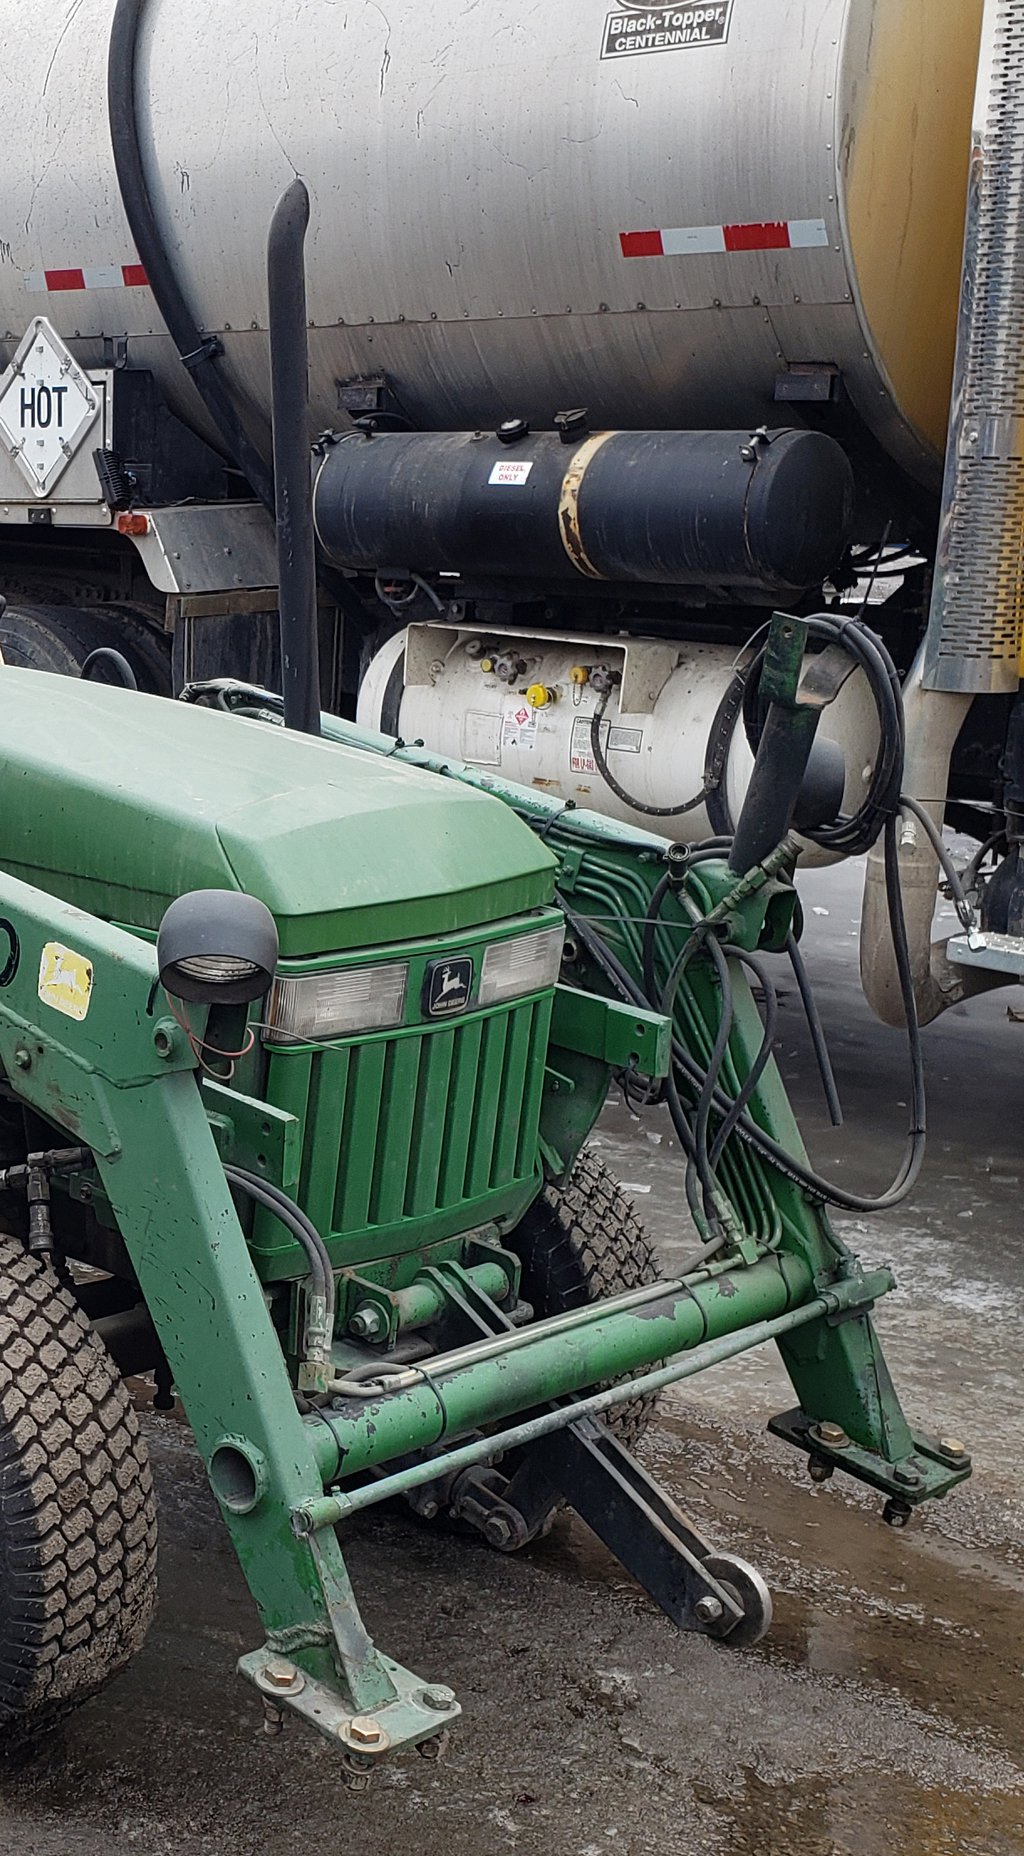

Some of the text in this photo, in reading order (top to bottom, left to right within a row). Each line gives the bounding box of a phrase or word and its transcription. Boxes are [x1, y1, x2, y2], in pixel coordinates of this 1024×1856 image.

[610, 7, 723, 34] Black-Topper
[615, 27, 711, 51] CENTENNIAL
[20, 386, 68, 429] HOT
[498, 464, 525, 472] DIESEL
[498, 473, 519, 481] ONLY
